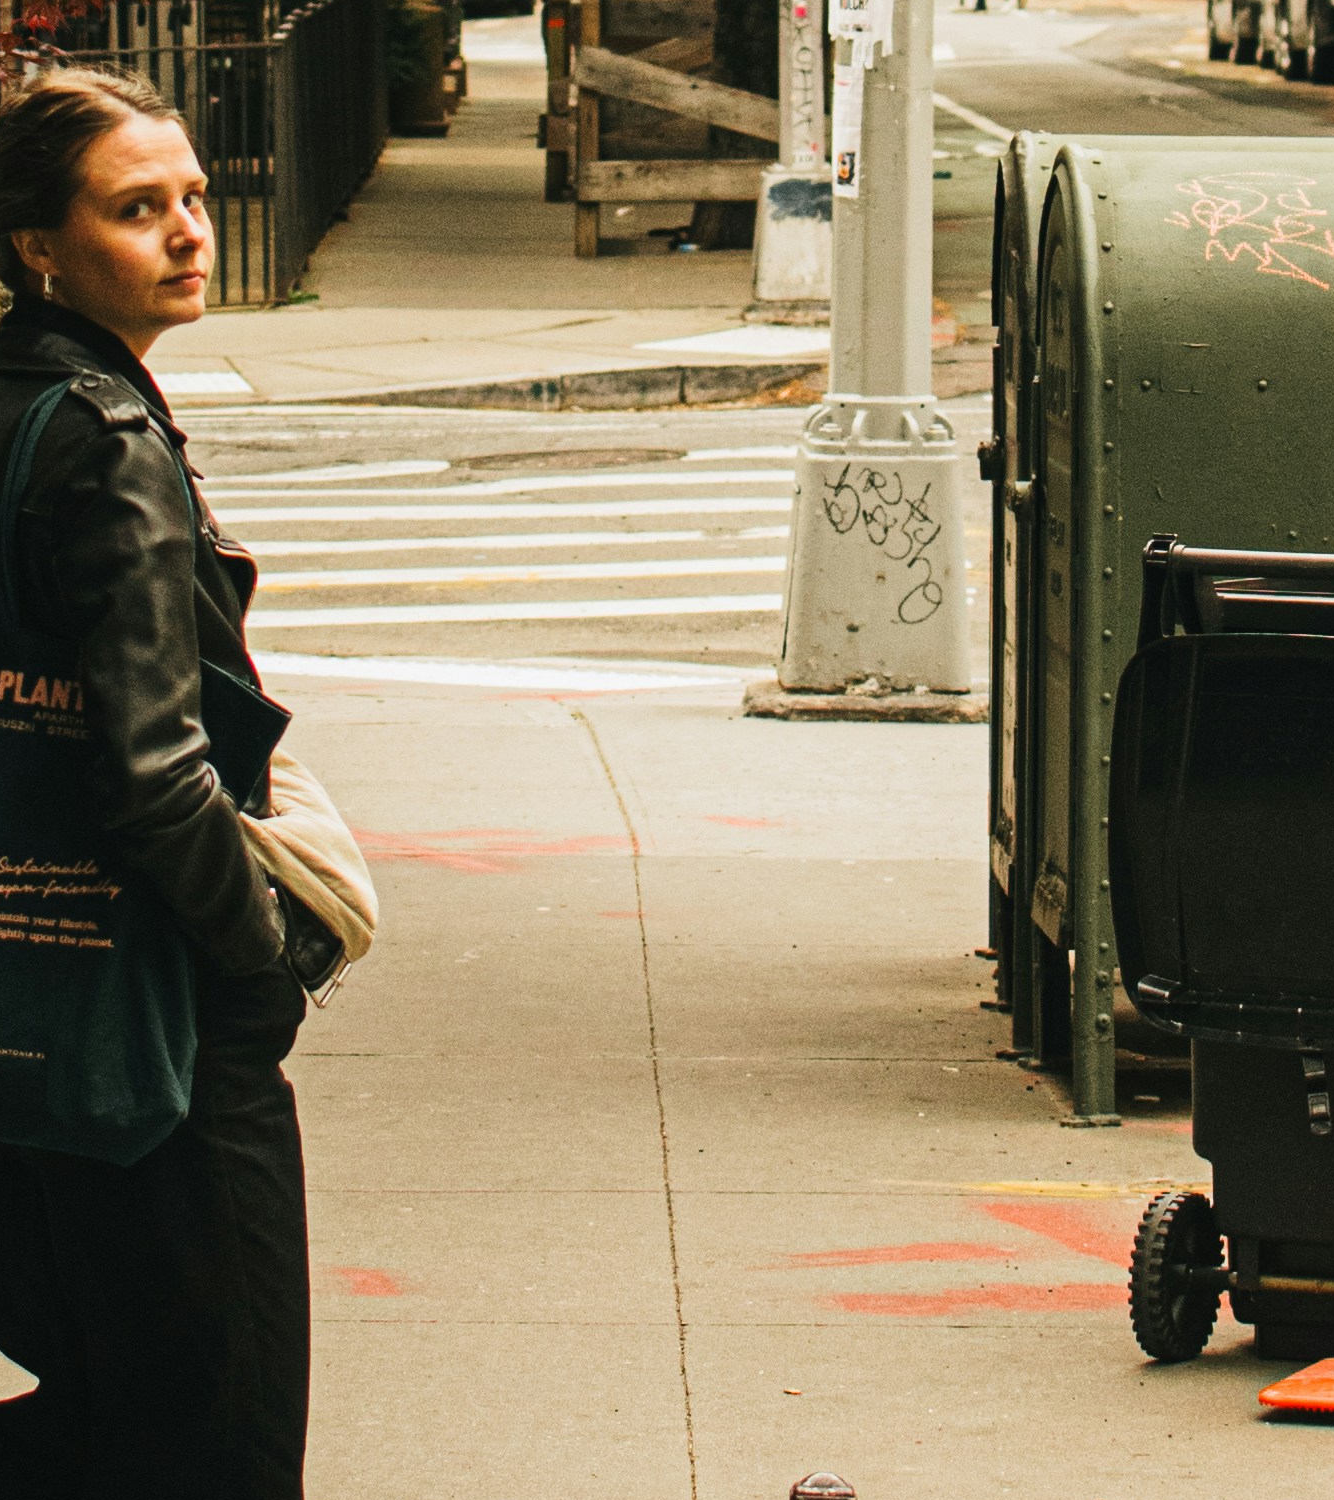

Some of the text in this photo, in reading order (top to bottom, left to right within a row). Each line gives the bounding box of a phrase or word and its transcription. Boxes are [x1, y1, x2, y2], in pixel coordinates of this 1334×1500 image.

[33, 916, 57, 929] your
[29, 932, 57, 944] upon
[58, 933, 77, 945] the
